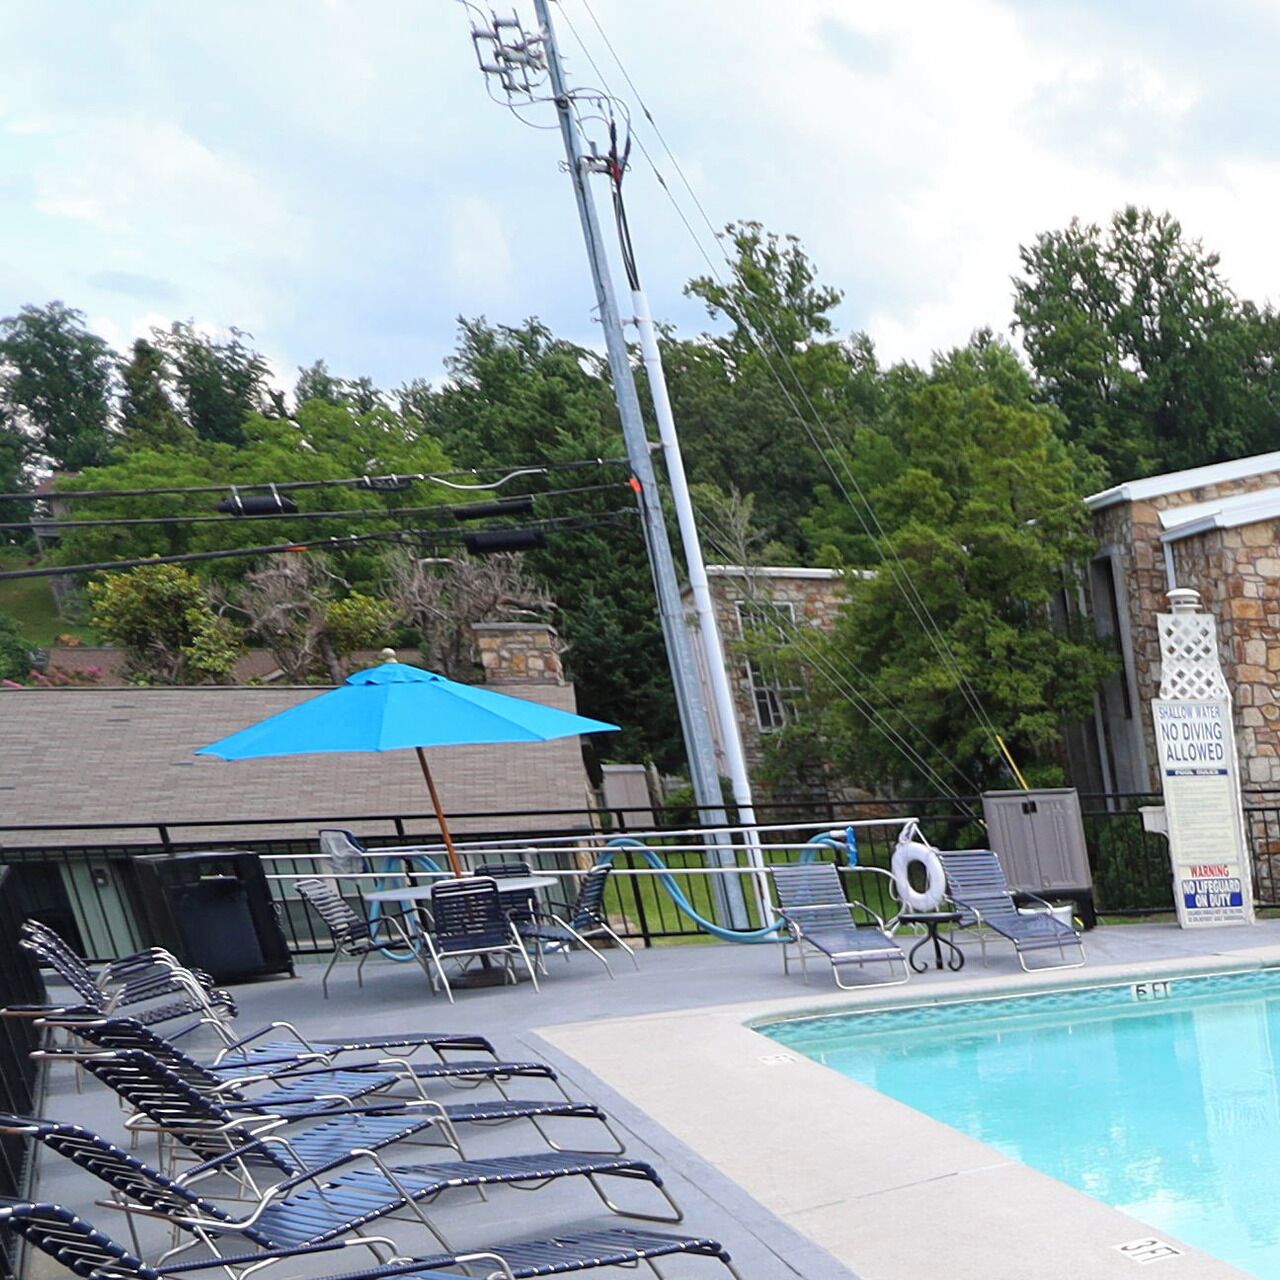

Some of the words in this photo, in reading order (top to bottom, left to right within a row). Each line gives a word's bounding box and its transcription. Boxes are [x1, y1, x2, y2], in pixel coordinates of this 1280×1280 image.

[1159, 706, 1192, 719] SHALLOW
[1193, 705, 1220, 718] WATER
[1161, 722, 1178, 741] NO
[1182, 722, 1222, 740] DIVING
[1166, 742, 1223, 761] ALLOWED
[1190, 864, 1230, 878] WARNING
[1182, 880, 1196, 894] NO
[1196, 879, 1240, 894] LIFEGUARD
[1195, 893, 1209, 907] ON
[1209, 892, 1231, 907] DUTY
